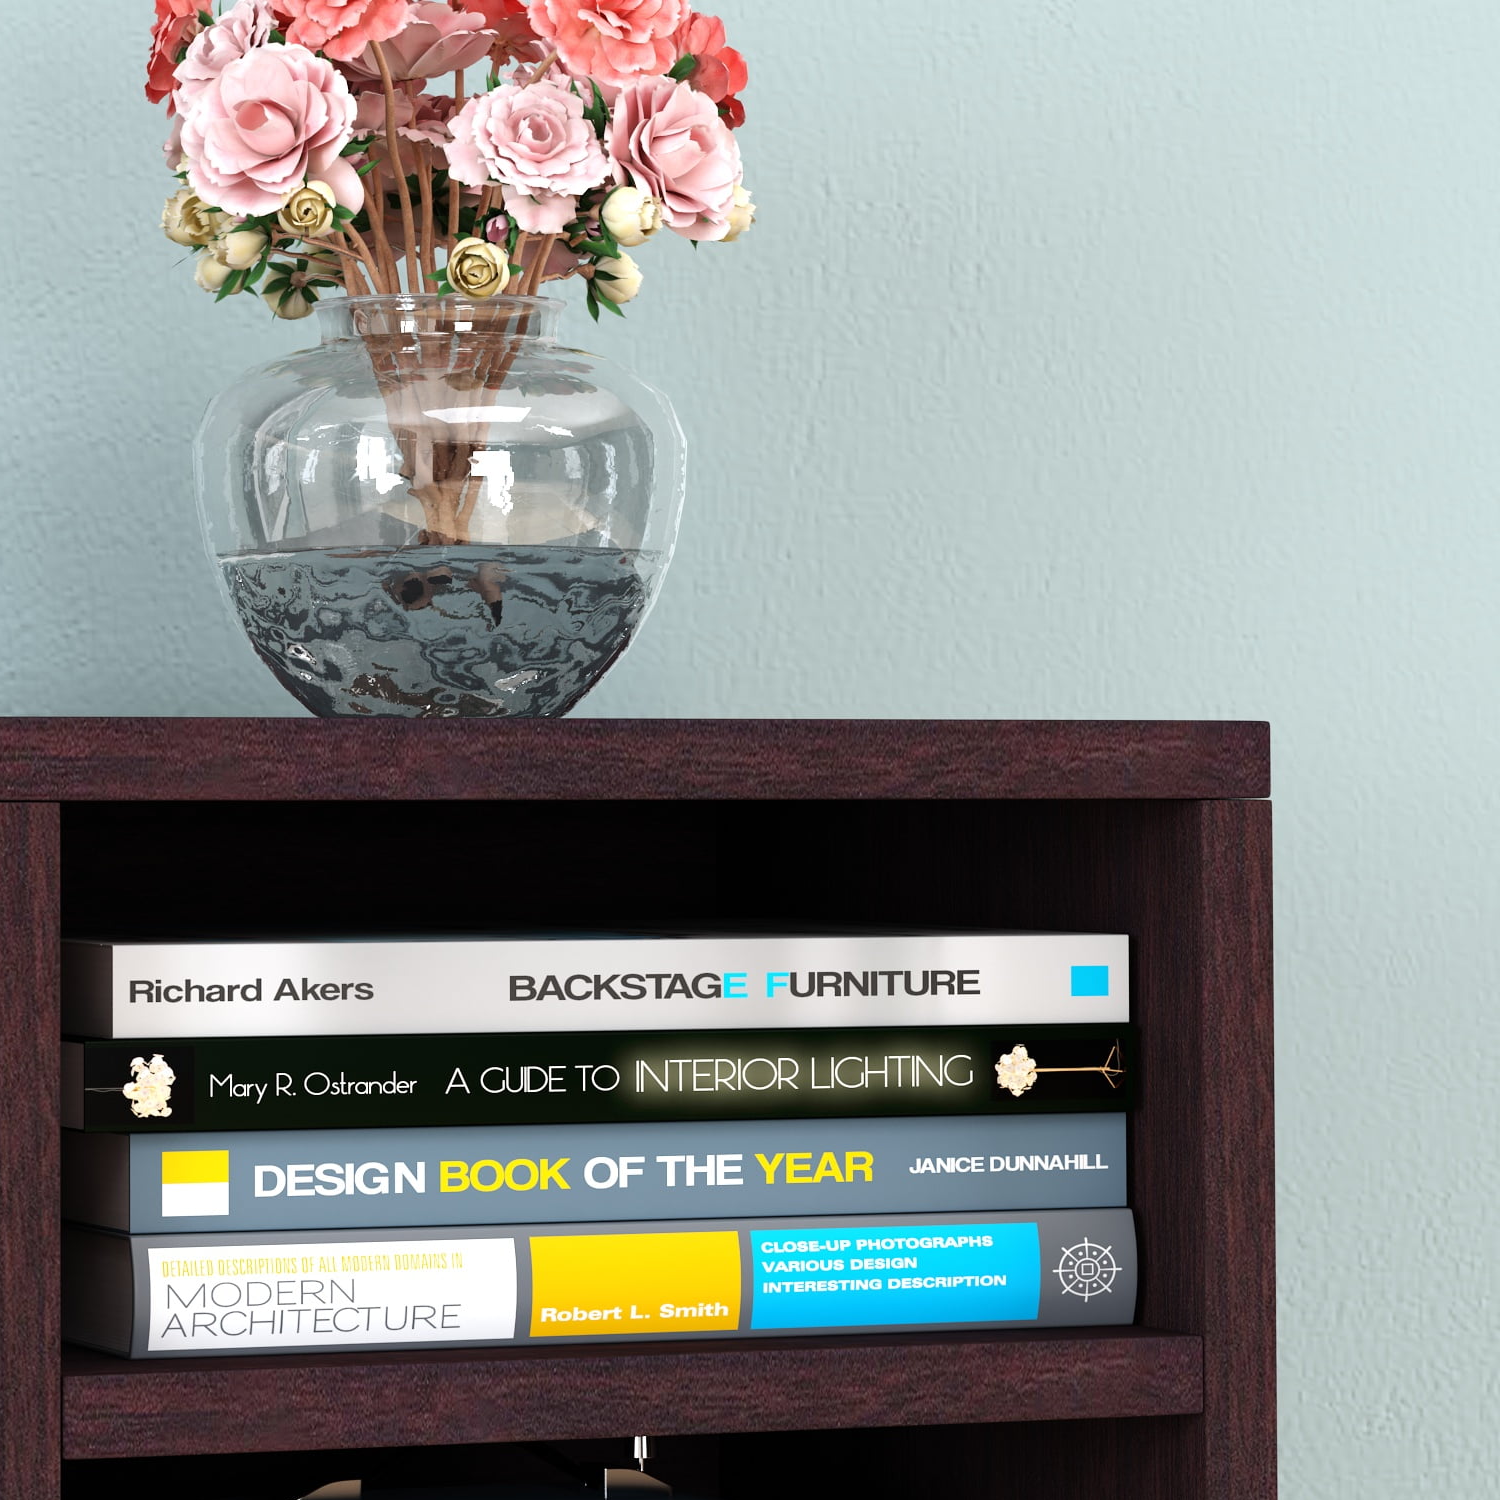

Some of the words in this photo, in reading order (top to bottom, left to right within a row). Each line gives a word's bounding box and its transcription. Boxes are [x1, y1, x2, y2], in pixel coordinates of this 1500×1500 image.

[129, 978, 262, 1003] Richard
[274, 977, 374, 1001] Akers
[509, 972, 748, 1001] BACKSTAGE
[767, 969, 980, 998] FURNITURE
[209, 1073, 267, 1104] Mary
[275, 1073, 297, 1096] R.
[304, 1071, 417, 1096] Ostrander
[445, 1068, 470, 1094] A
[480, 1066, 566, 1093] GUIDE
[574, 1065, 620, 1091] TO
[636, 1058, 799, 1093] INTERIOR
[811, 1055, 973, 1089] LIGHTING
[253, 1162, 426, 1198] DESIGN
[439, 1158, 571, 1193] BOOK
[583, 1156, 645, 1190] OF
[656, 1154, 743, 1187] THE
[755, 1151, 874, 1184] YEAR
[909, 1156, 985, 1175] JANICE
[990, 1154, 1108, 1173] DUNNAHILL
[760, 1240, 852, 1254] CLOSE-UP
[856, 1235, 993, 1251] PHOTOGRAPHS
[161, 1258, 214, 1278] DETAILED
[218, 1257, 297, 1276] DESCRIPTIONS
[301, 1257, 315, 1274] OF
[319, 1255, 338, 1273] ALL
[341, 1254, 391, 1272] MODERN
[394, 1253, 448, 1271] DOMAINS
[450, 1252, 464, 1270] IN
[761, 1260, 844, 1273] VARIOUS
[850, 1257, 918, 1271] DESIGN
[166, 1278, 356, 1310] MODERN
[762, 1278, 883, 1293] INTERESTING
[887, 1274, 1007, 1290] DESCRIPTION
[161, 1304, 461, 1339] ARCHITECTURE
[541, 1306, 622, 1323] Robert
[630, 1306, 650, 1320] L.
[659, 1303, 729, 1319] Smith
